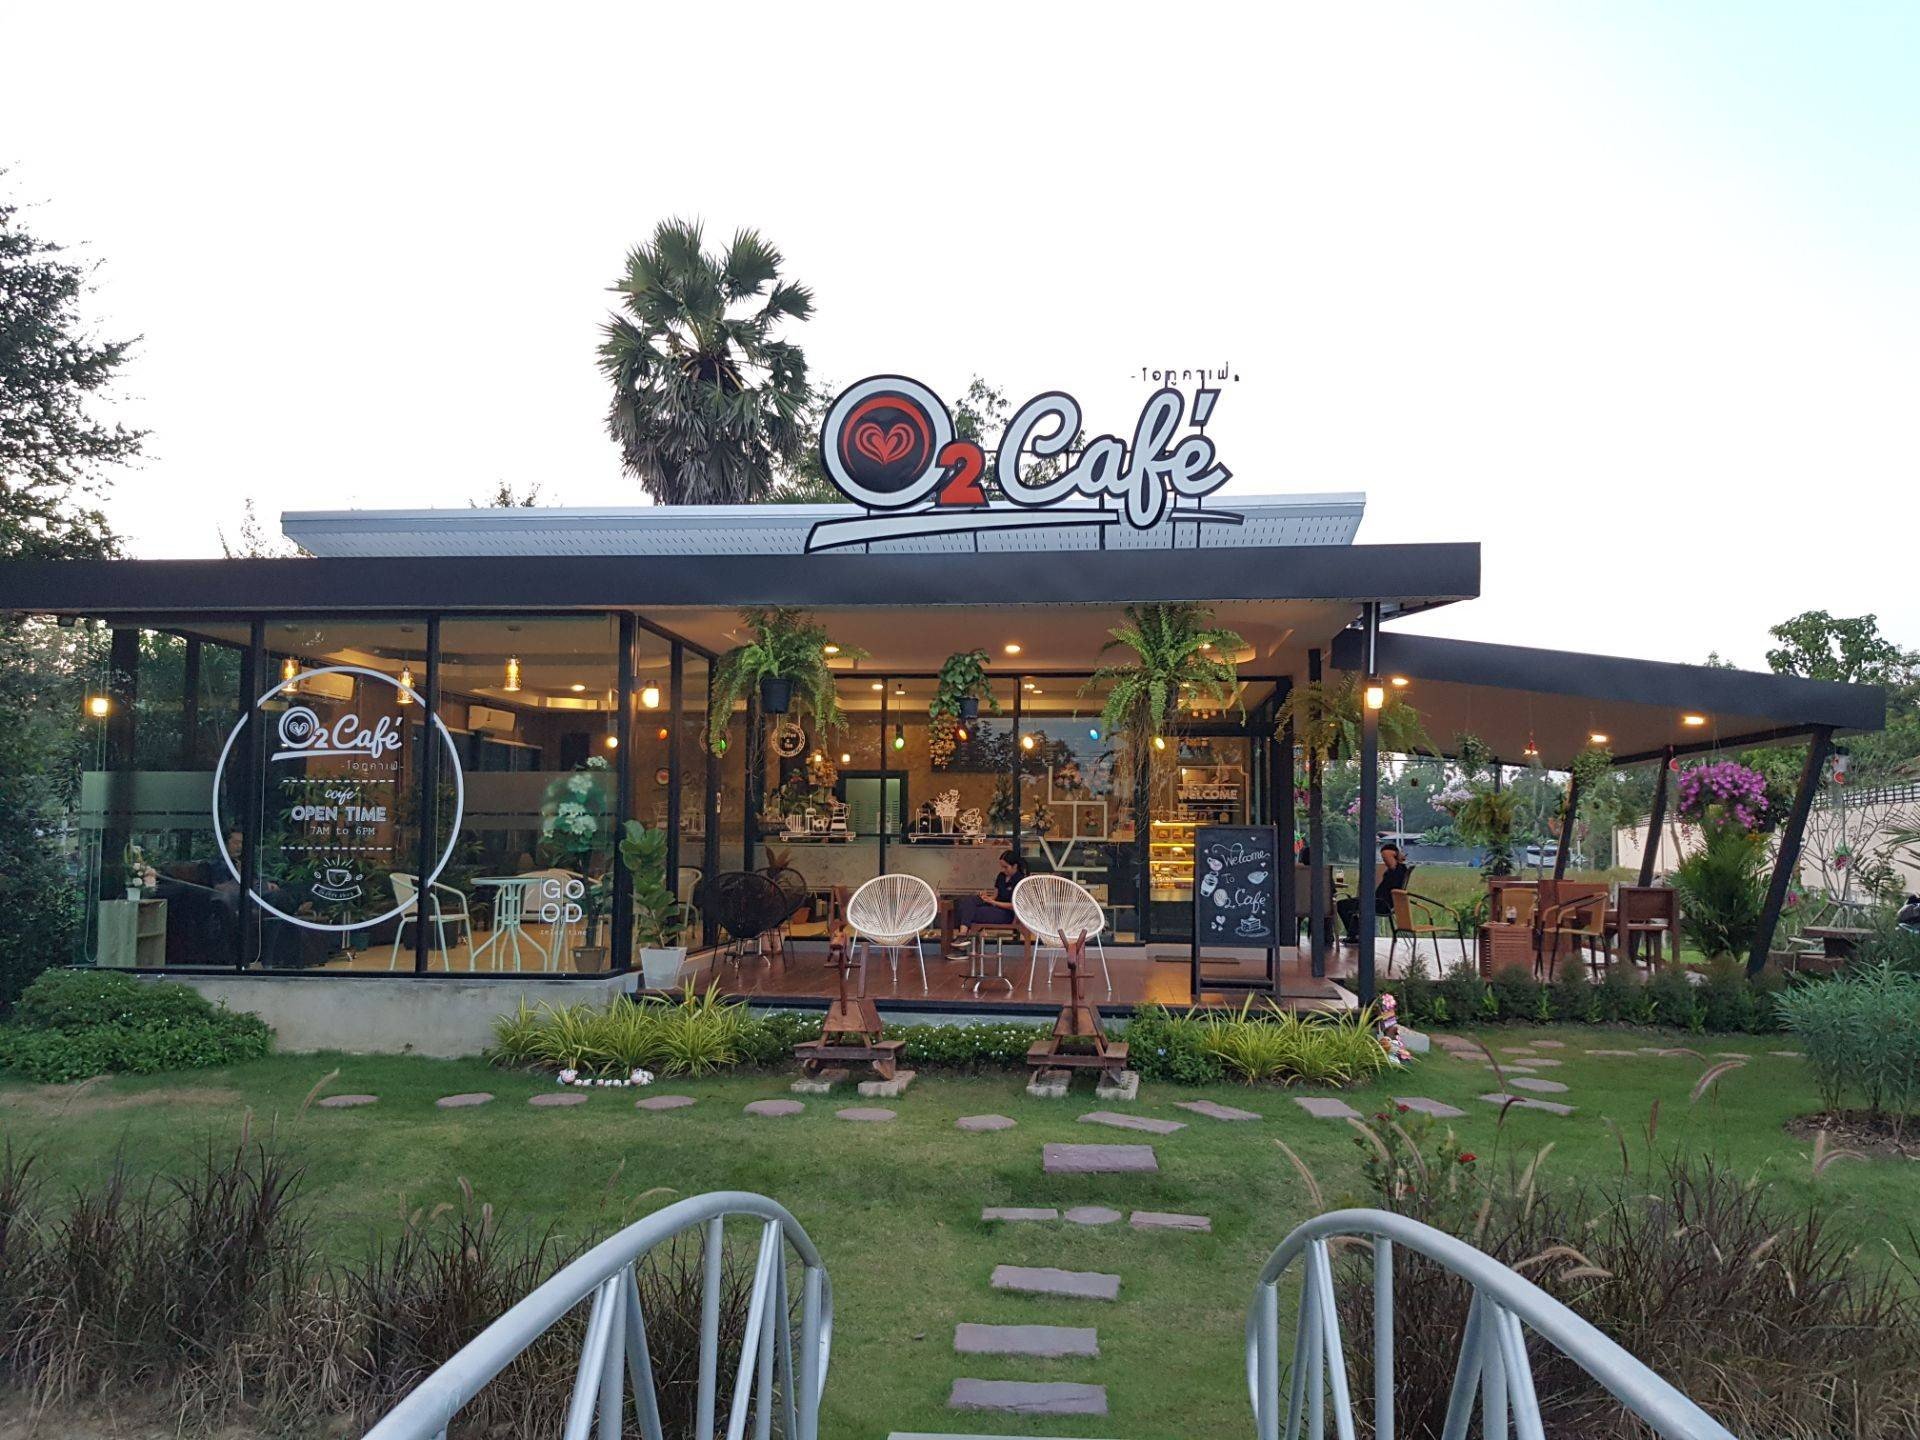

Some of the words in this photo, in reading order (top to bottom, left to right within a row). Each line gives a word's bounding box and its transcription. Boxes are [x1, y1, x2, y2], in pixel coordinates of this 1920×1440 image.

[997, 388, 1233, 530] Café
[332, 713, 403, 758] Café
[1177, 789, 1238, 800] WELCOME
[291, 805, 338, 821] OPEN
[345, 806, 387, 822] TIME
[310, 826, 331, 836] 7AM
[336, 826, 349, 835] to
[355, 826, 376, 836] 6PM
[1221, 850, 1270, 867] Welcome
